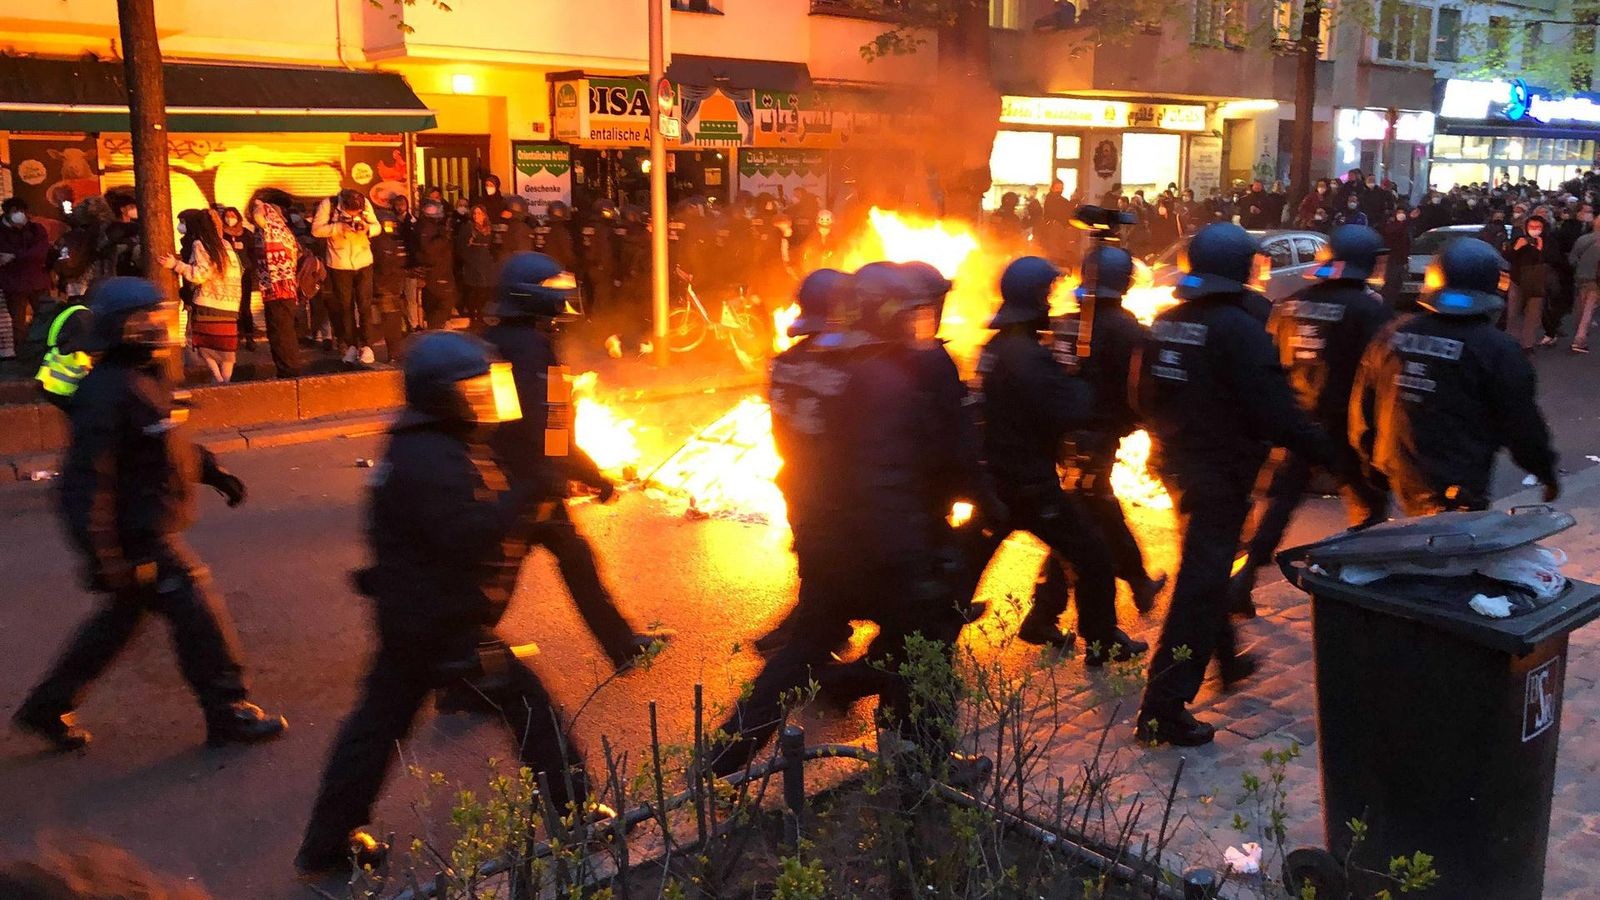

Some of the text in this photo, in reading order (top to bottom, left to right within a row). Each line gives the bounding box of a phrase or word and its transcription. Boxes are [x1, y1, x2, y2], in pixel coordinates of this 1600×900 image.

[588, 86, 652, 116] BISA
[590, 128, 640, 140] entalische
[524, 184, 561, 193] Geschenke
